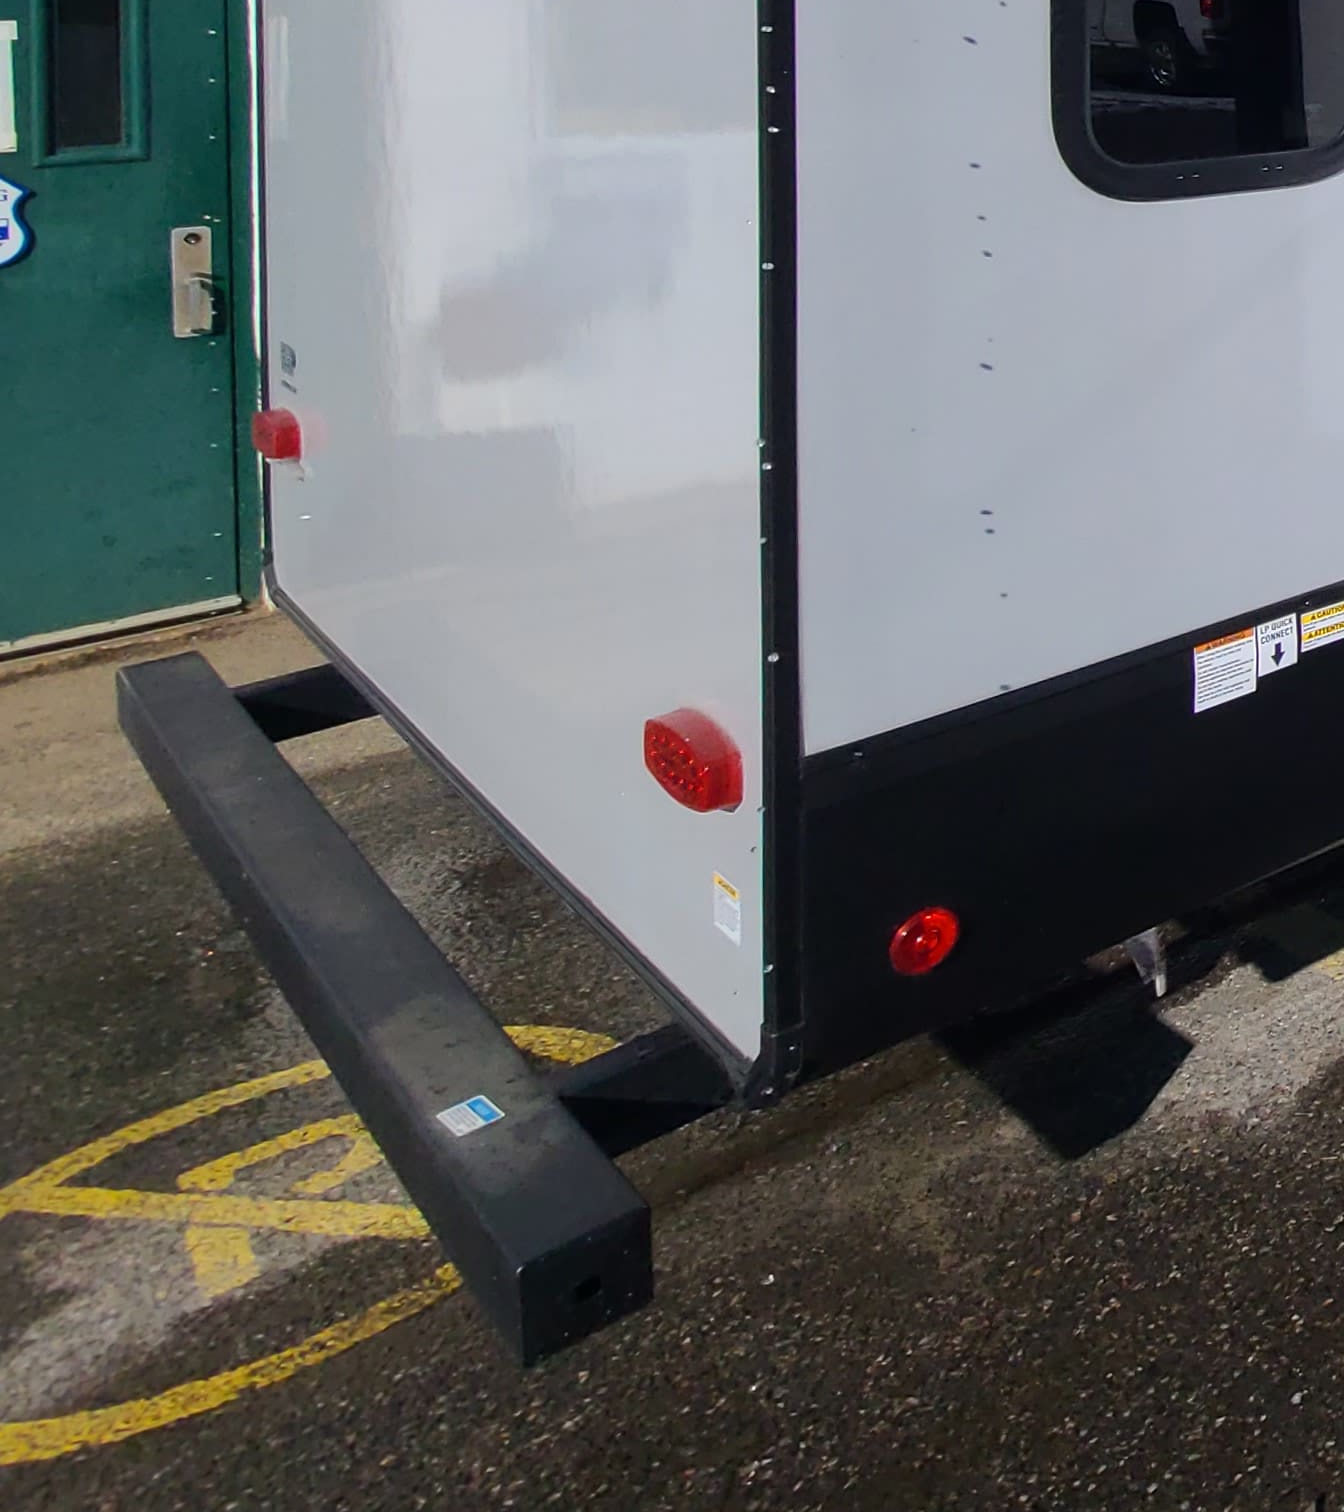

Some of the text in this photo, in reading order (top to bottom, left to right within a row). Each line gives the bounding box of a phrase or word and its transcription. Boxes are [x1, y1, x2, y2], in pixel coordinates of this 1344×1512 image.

[1260, 624, 1270, 635] LP
[1271, 617, 1292, 630] QUICK
[1260, 626, 1293, 644] CONNECT
